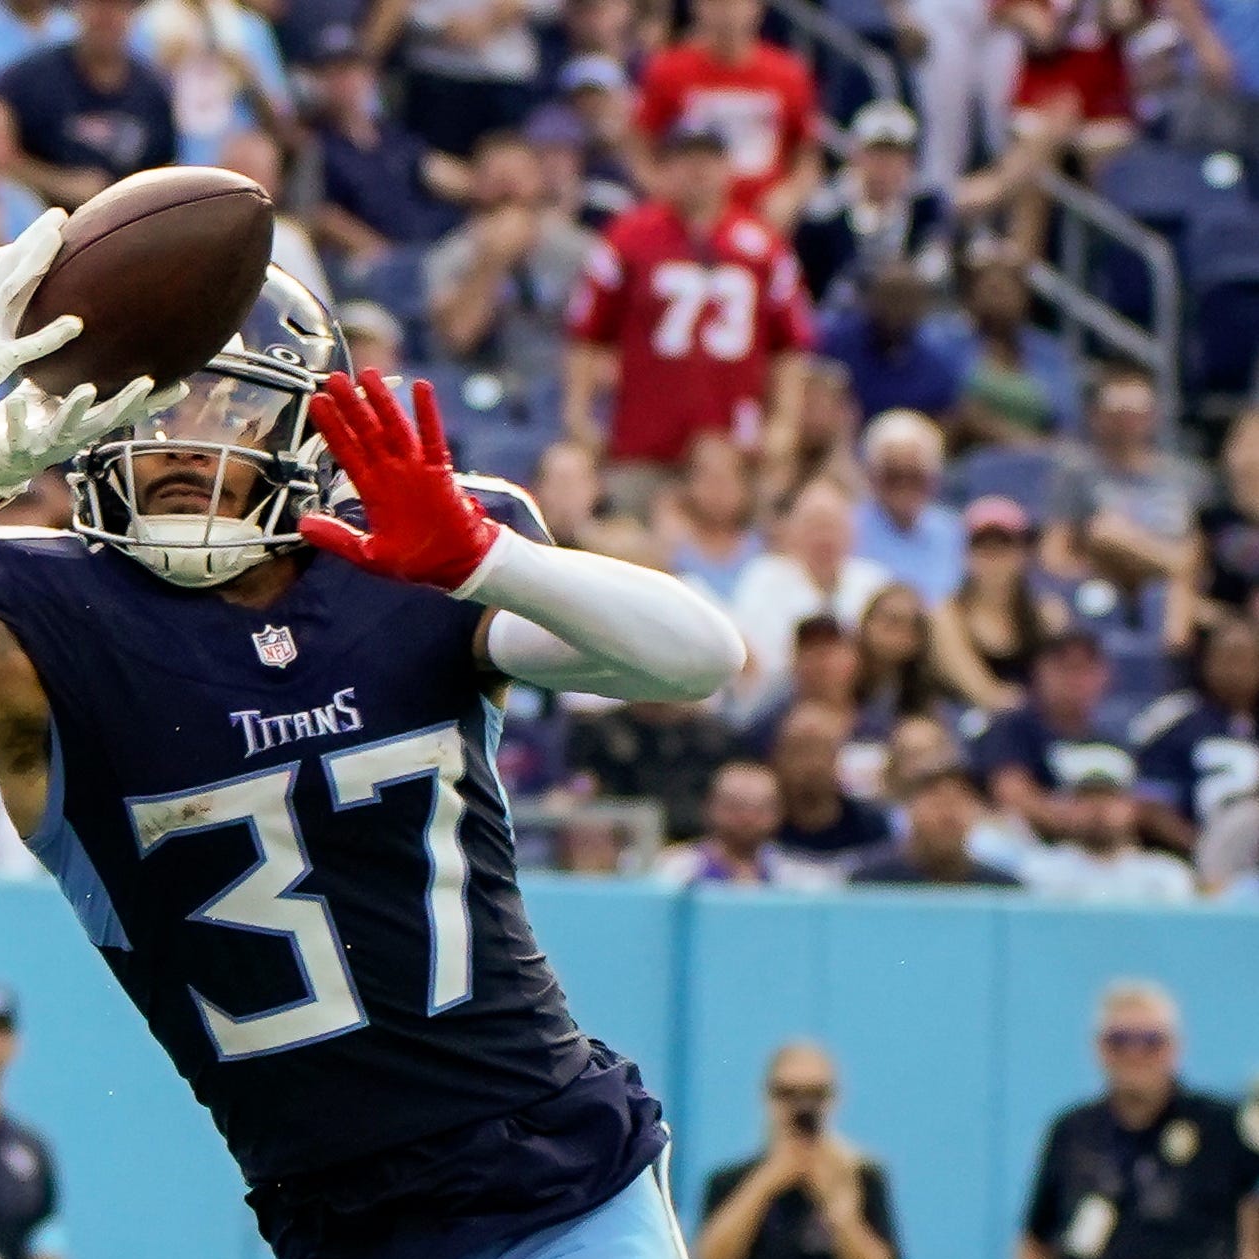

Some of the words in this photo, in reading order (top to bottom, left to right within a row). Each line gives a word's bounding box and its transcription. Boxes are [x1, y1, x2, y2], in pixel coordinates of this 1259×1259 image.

[652, 263, 756, 360] 73
[230, 686, 364, 759] TITANS
[124, 720, 474, 1062] 37
